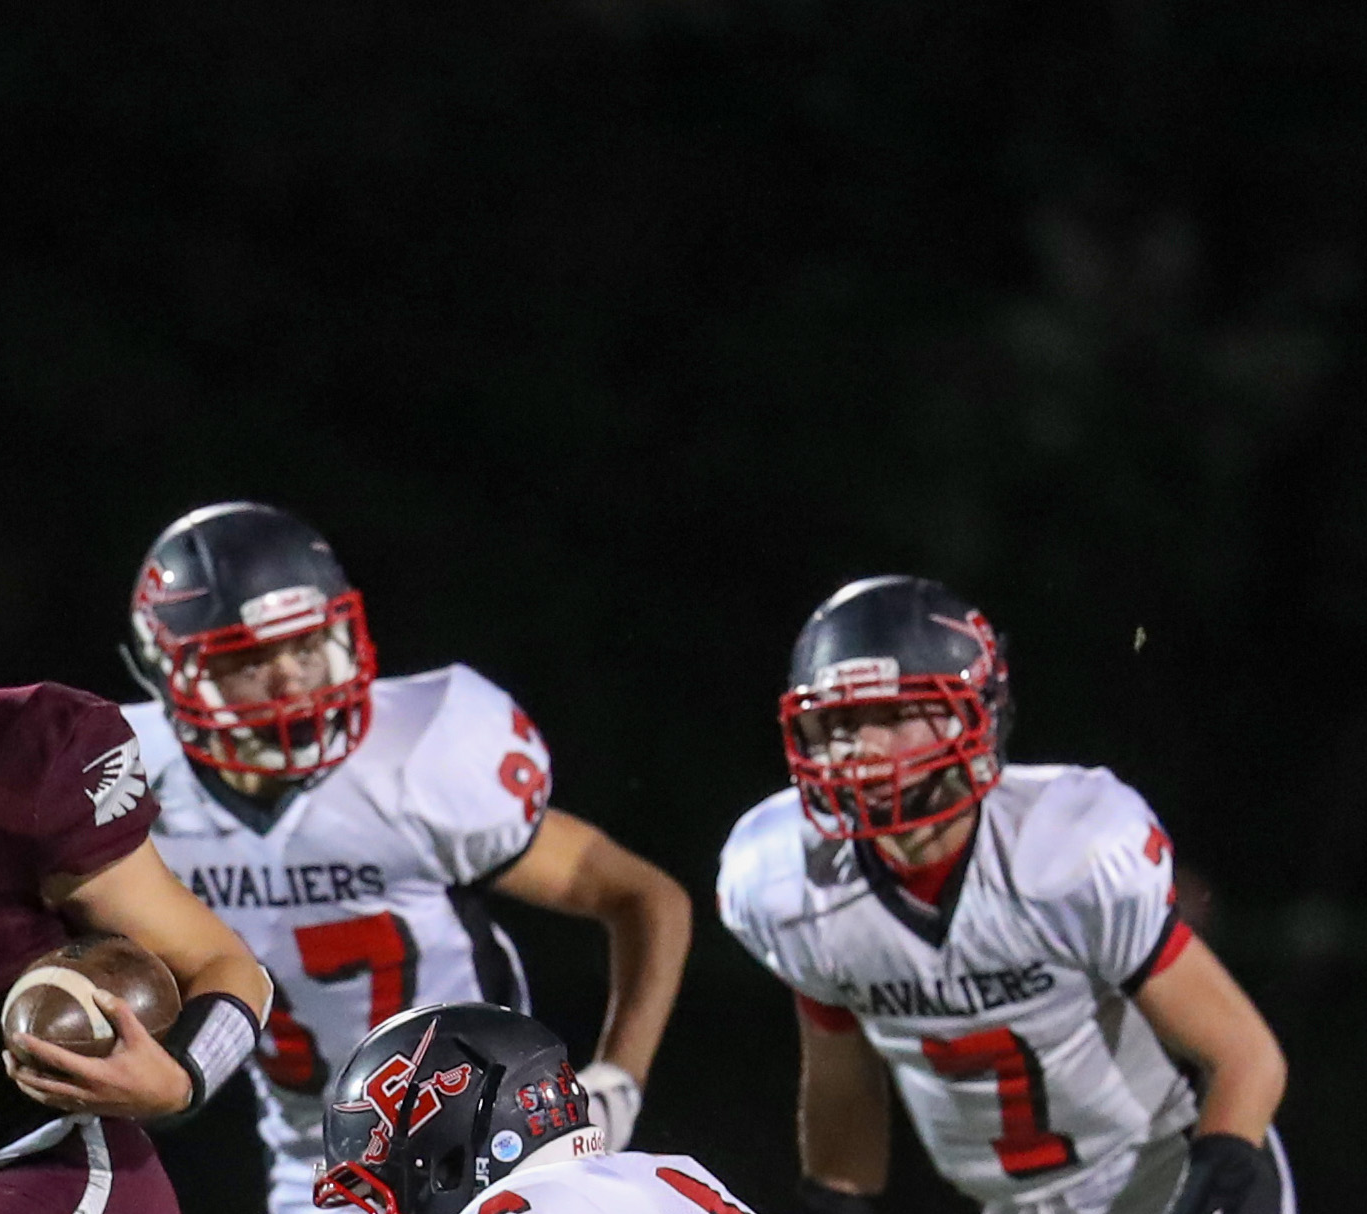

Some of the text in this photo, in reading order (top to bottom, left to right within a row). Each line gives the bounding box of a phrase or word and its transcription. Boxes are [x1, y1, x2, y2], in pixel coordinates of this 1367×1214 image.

[180, 863, 386, 909] AVALIERS
[364, 1053, 443, 1138] E
[921, 1025, 1080, 1180] 7
[572, 1131, 605, 1156] Ridd
